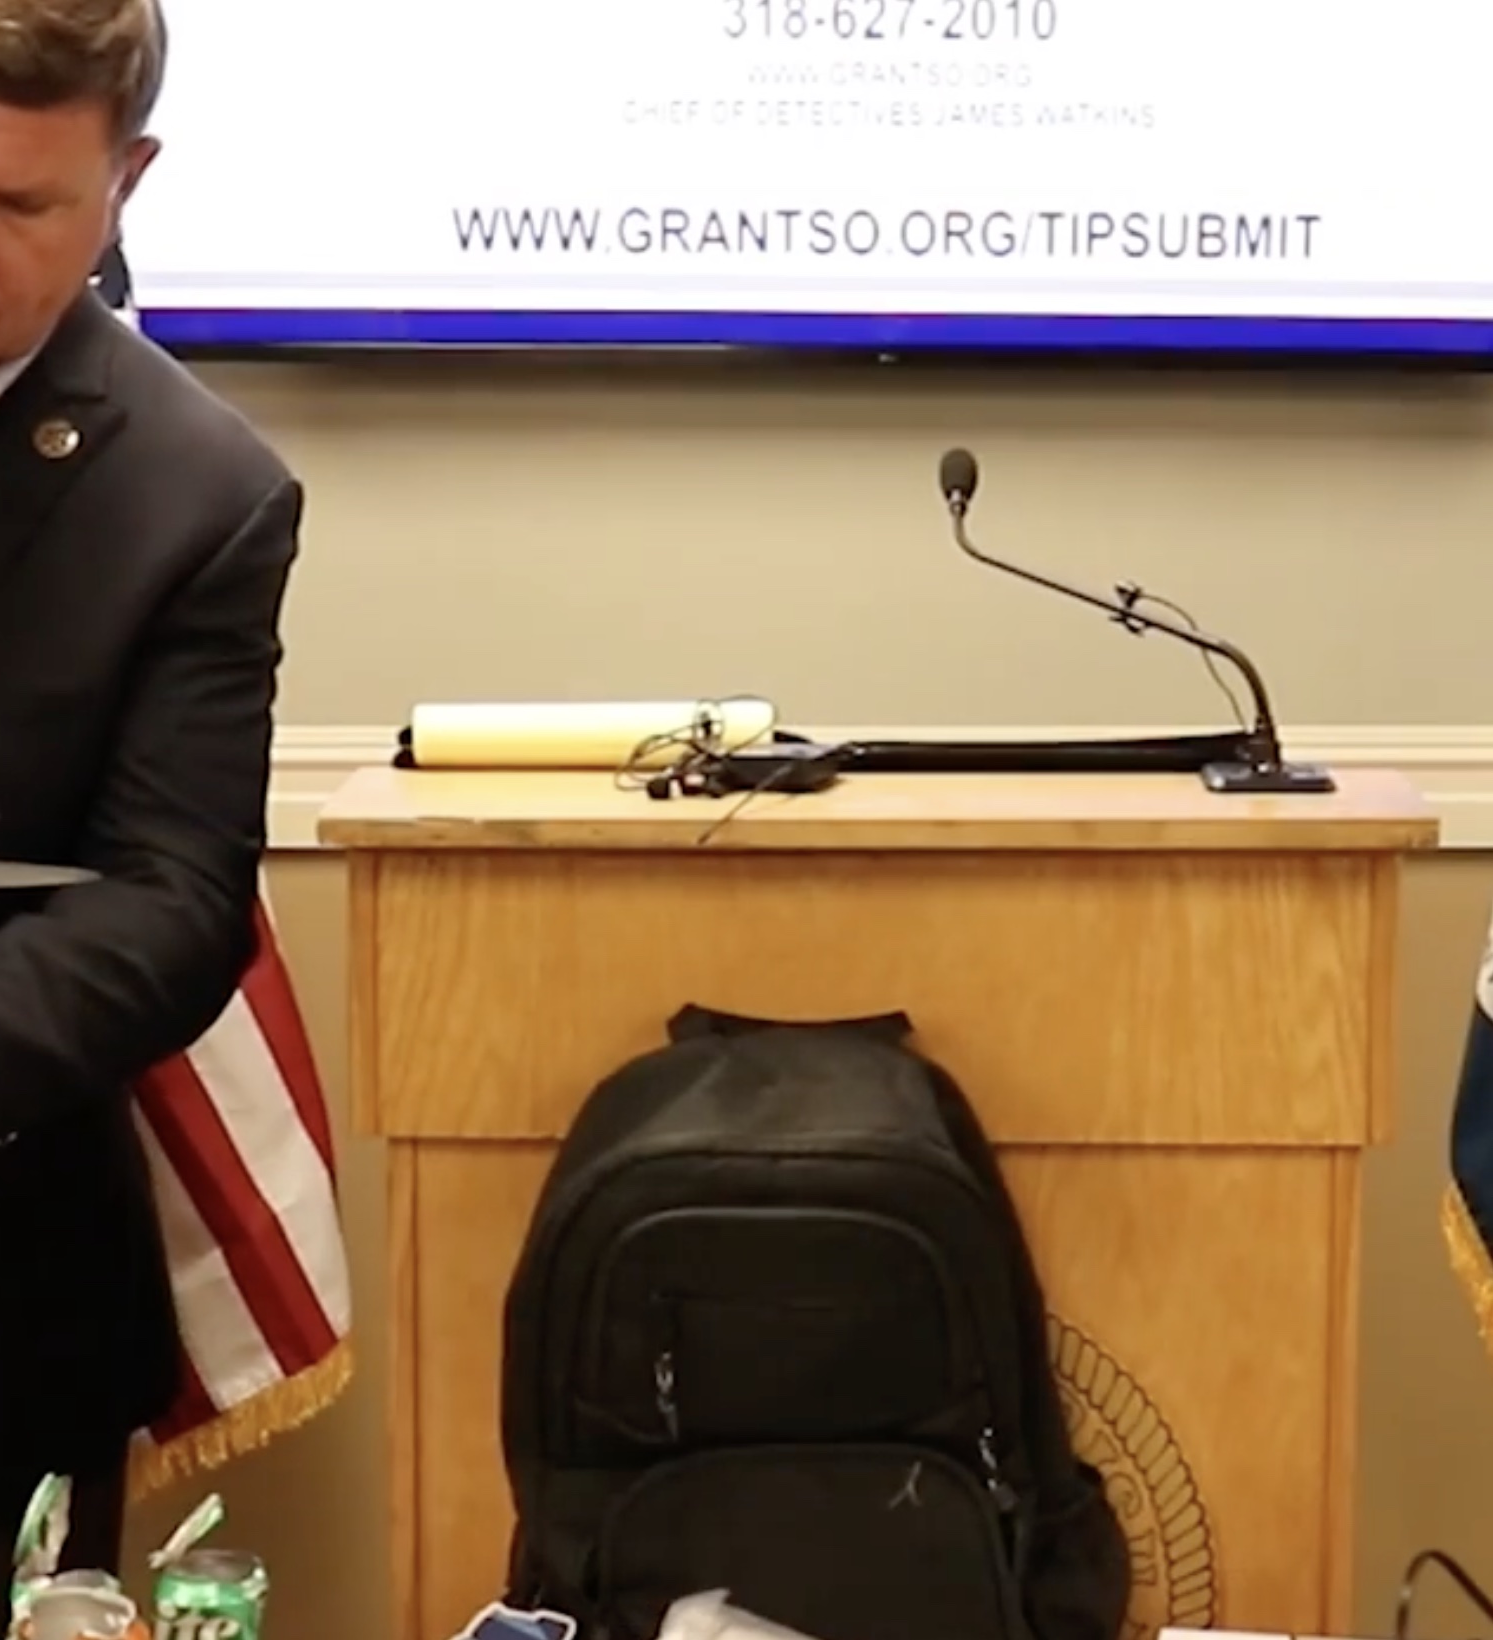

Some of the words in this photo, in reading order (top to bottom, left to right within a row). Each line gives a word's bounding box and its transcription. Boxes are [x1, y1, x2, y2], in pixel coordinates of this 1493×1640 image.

[725, 0, 1057, 40] 318-627-2010
[622, 100, 701, 129] CHIEF
[713, 100, 745, 129] OF
[756, 100, 924, 130] DETECTIVES
[934, 102, 1024, 131] JAMES
[1035, 103, 1155, 132] WATKINS
[453, 207, 1321, 258] WWW.GRANTSO.ORG/TIPSUBMIT
